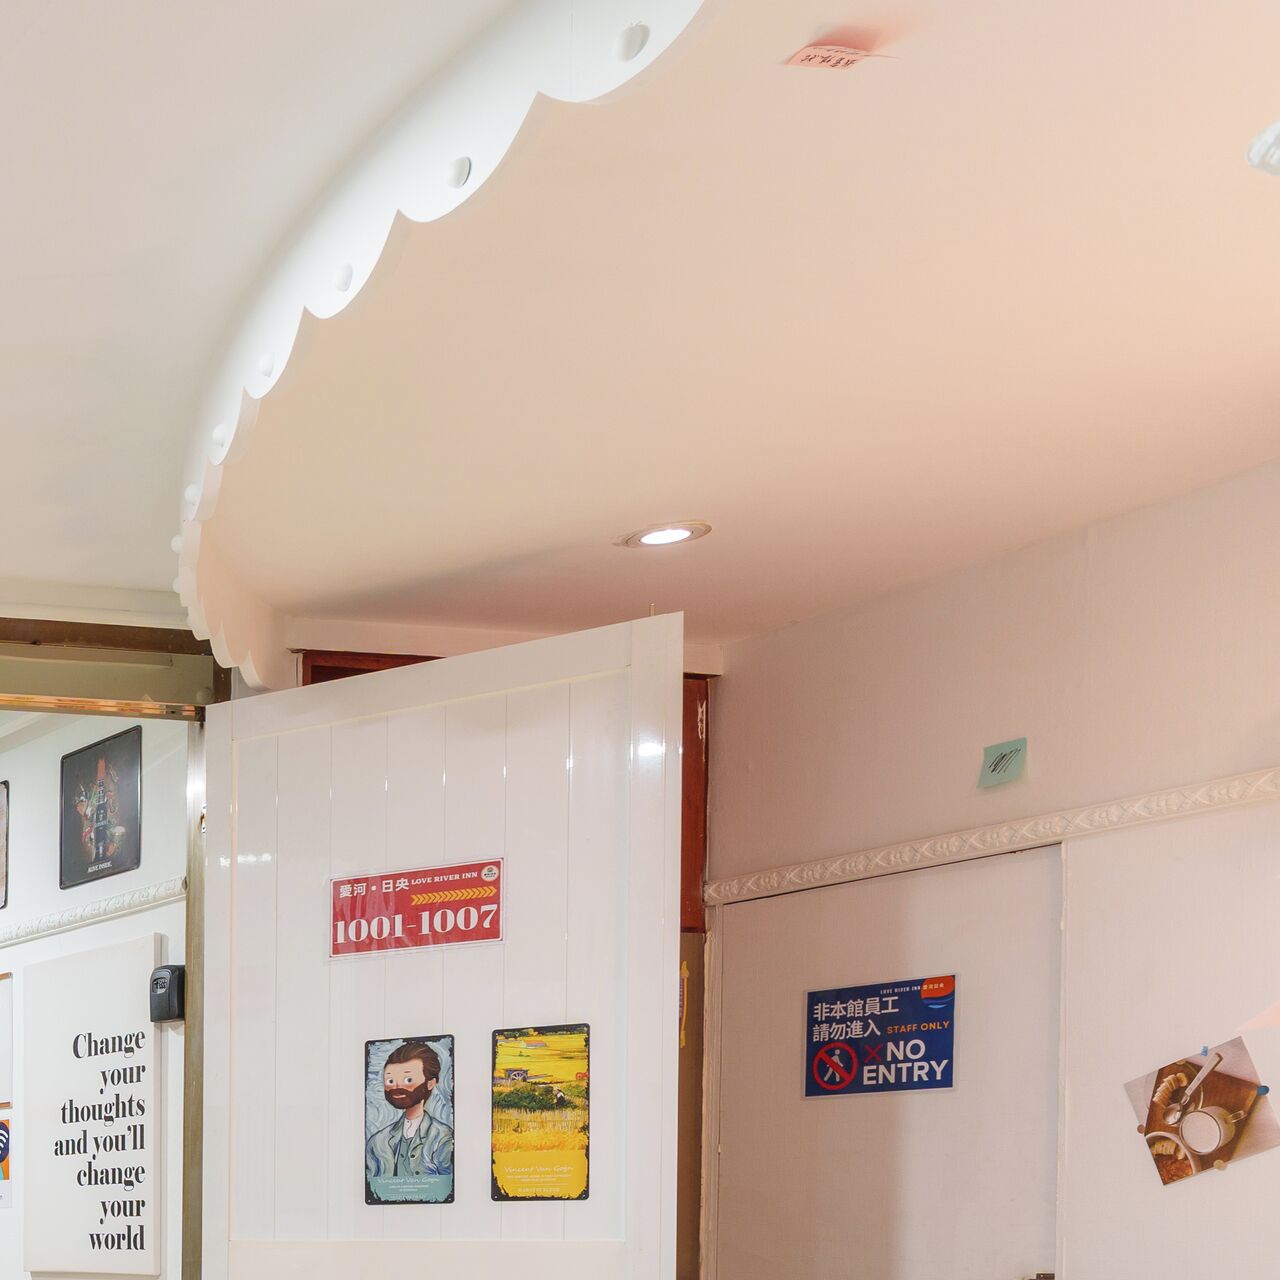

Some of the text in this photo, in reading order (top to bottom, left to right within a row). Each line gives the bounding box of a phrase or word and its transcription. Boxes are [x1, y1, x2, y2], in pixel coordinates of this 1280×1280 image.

[411, 877, 433, 886] LOVE
[433, 873, 461, 883] RIVER
[461, 871, 479, 880] INN
[333, 903, 498, 945] 1001-1007
[812, 996, 900, 1021] 非本館員工
[812, 1019, 881, 1042] 請勿進入
[886, 1020, 950, 1034] STAFF ONLY
[72, 1030, 146, 1060] Change
[886, 1039, 926, 1061] NO
[99, 1063, 146, 1095] your
[863, 1059, 949, 1086] ENTRY
[60, 1092, 146, 1128] thoughts
[54, 1124, 146, 1161] and you'll
[76, 1160, 146, 1192] change
[99, 1198, 146, 1225] your
[88, 1224, 146, 1251] world
